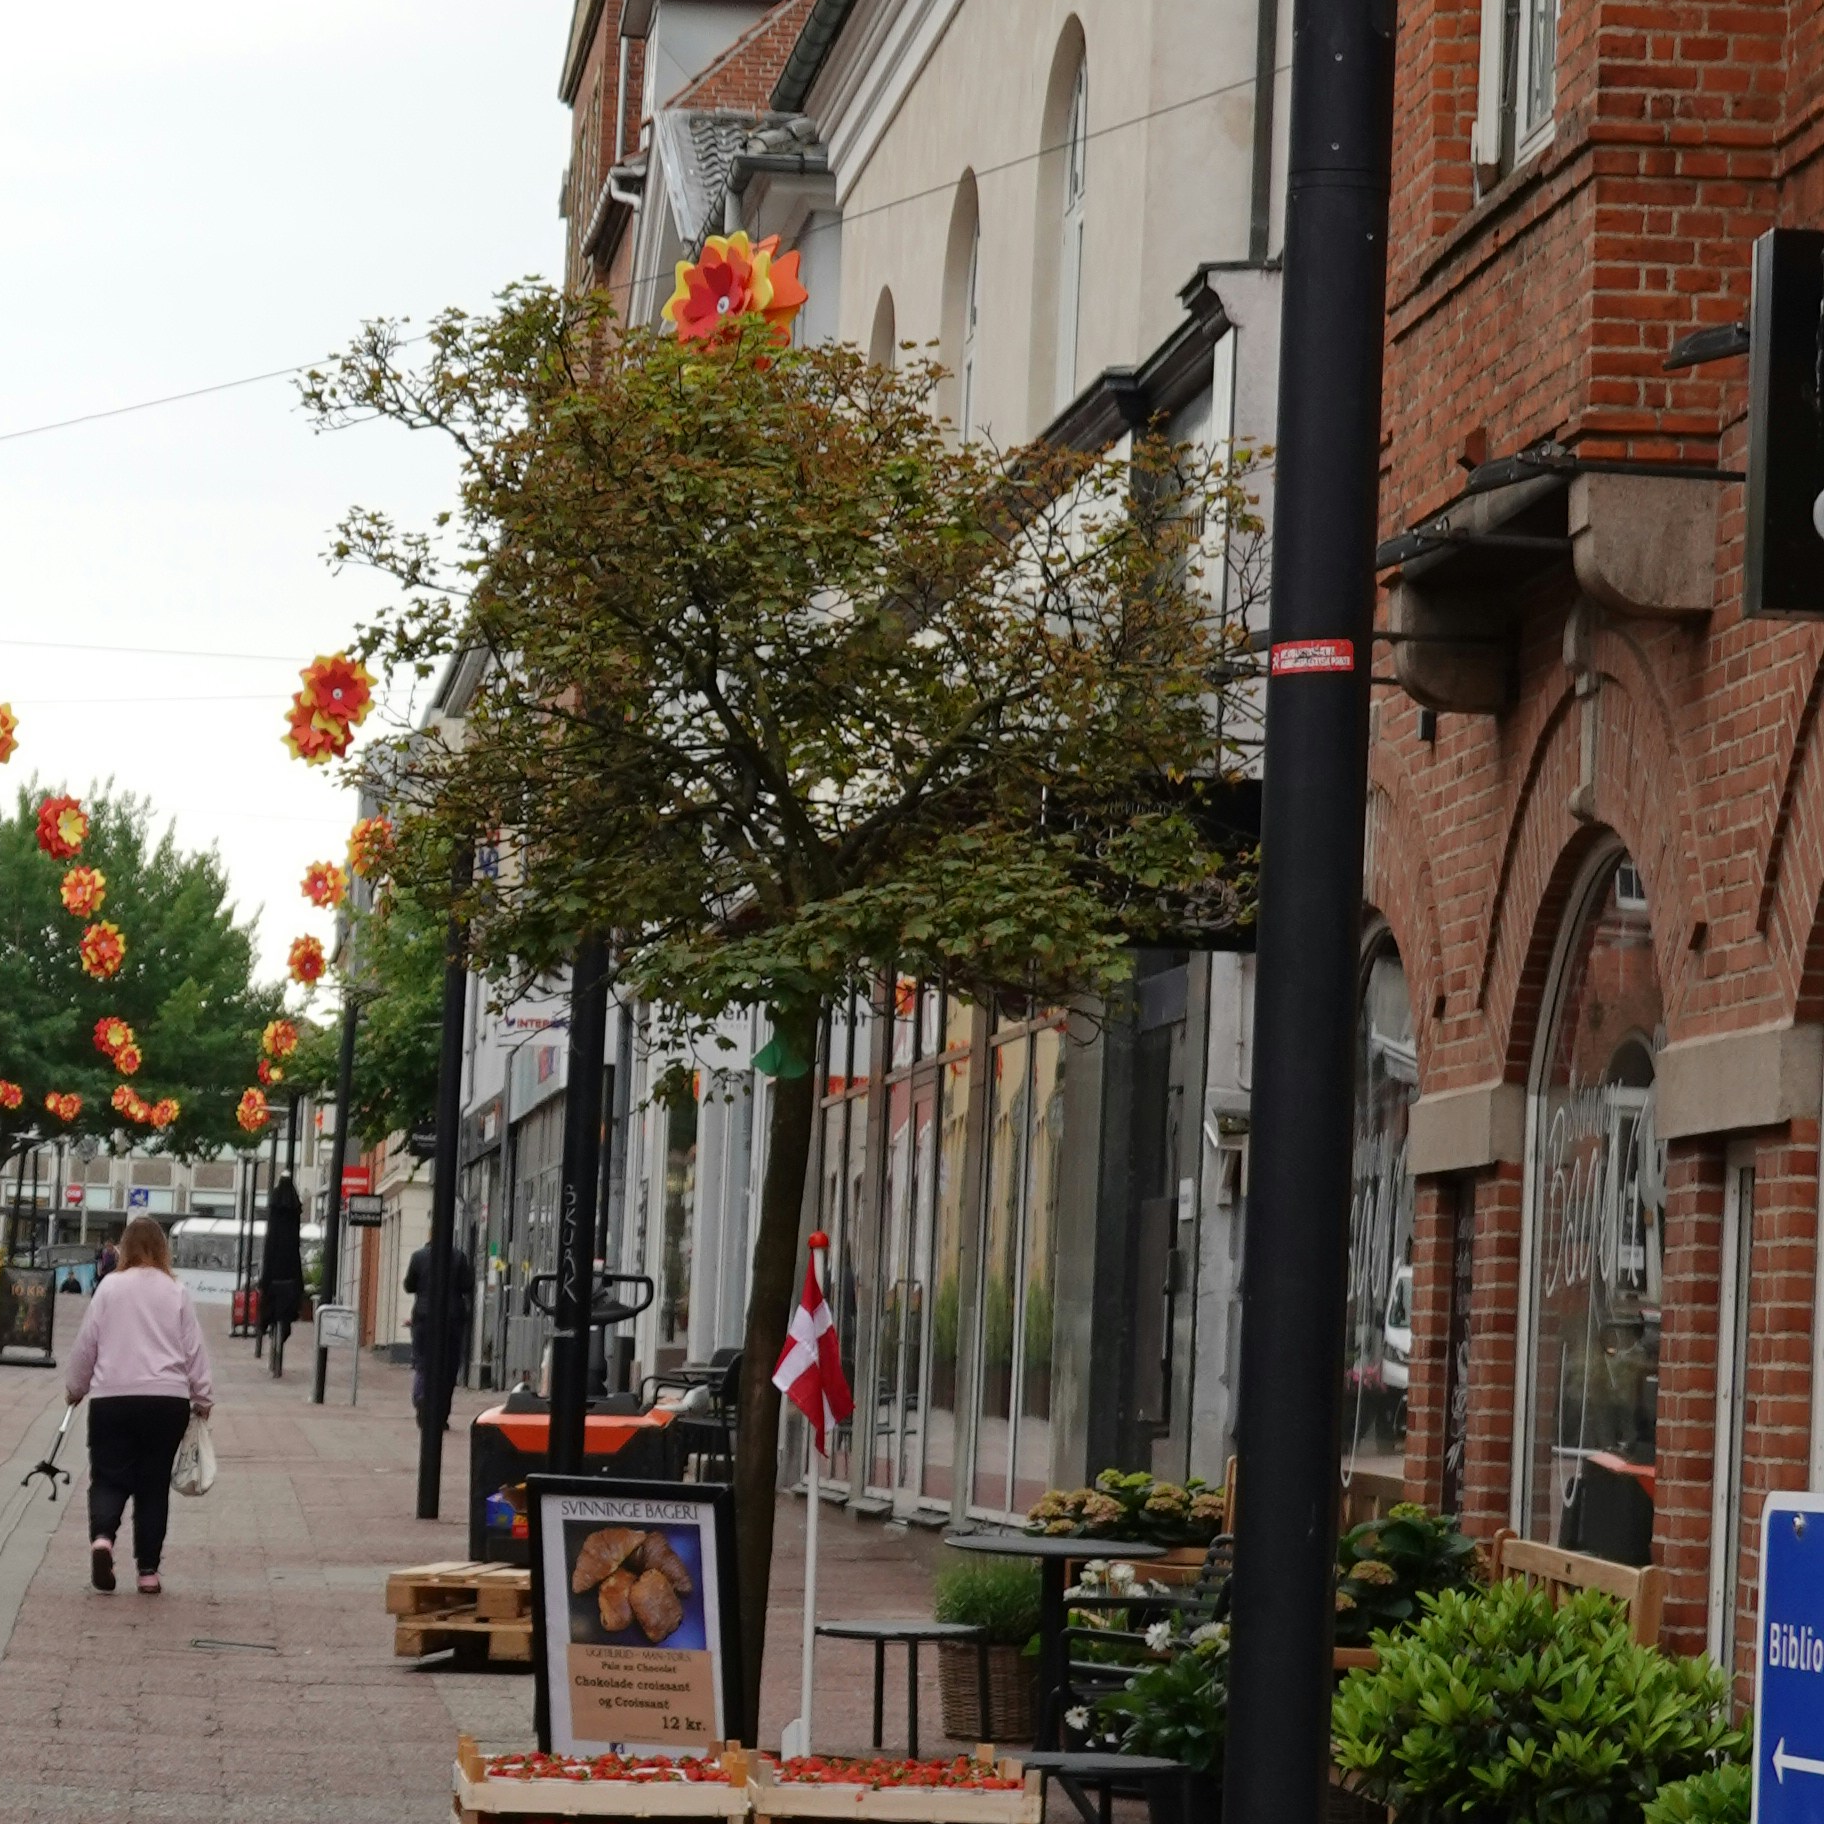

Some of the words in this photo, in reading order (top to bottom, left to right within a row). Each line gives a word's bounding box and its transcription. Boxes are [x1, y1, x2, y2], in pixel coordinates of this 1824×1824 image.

[561, 1500, 641, 1518] SVINNINGE
[645, 1504, 699, 1520] BAGERI
[1769, 1622, 1824, 1673] Biblio
[637, 1663, 677, 1674] Chocolat
[575, 1676, 634, 1689] Chokolade
[637, 1681, 691, 1692] croissant
[598, 1698, 612, 1709] og
[614, 1697, 670, 1710] Croissant
[662, 1716, 681, 1730] 12
[685, 1717, 706, 1731] kr.
